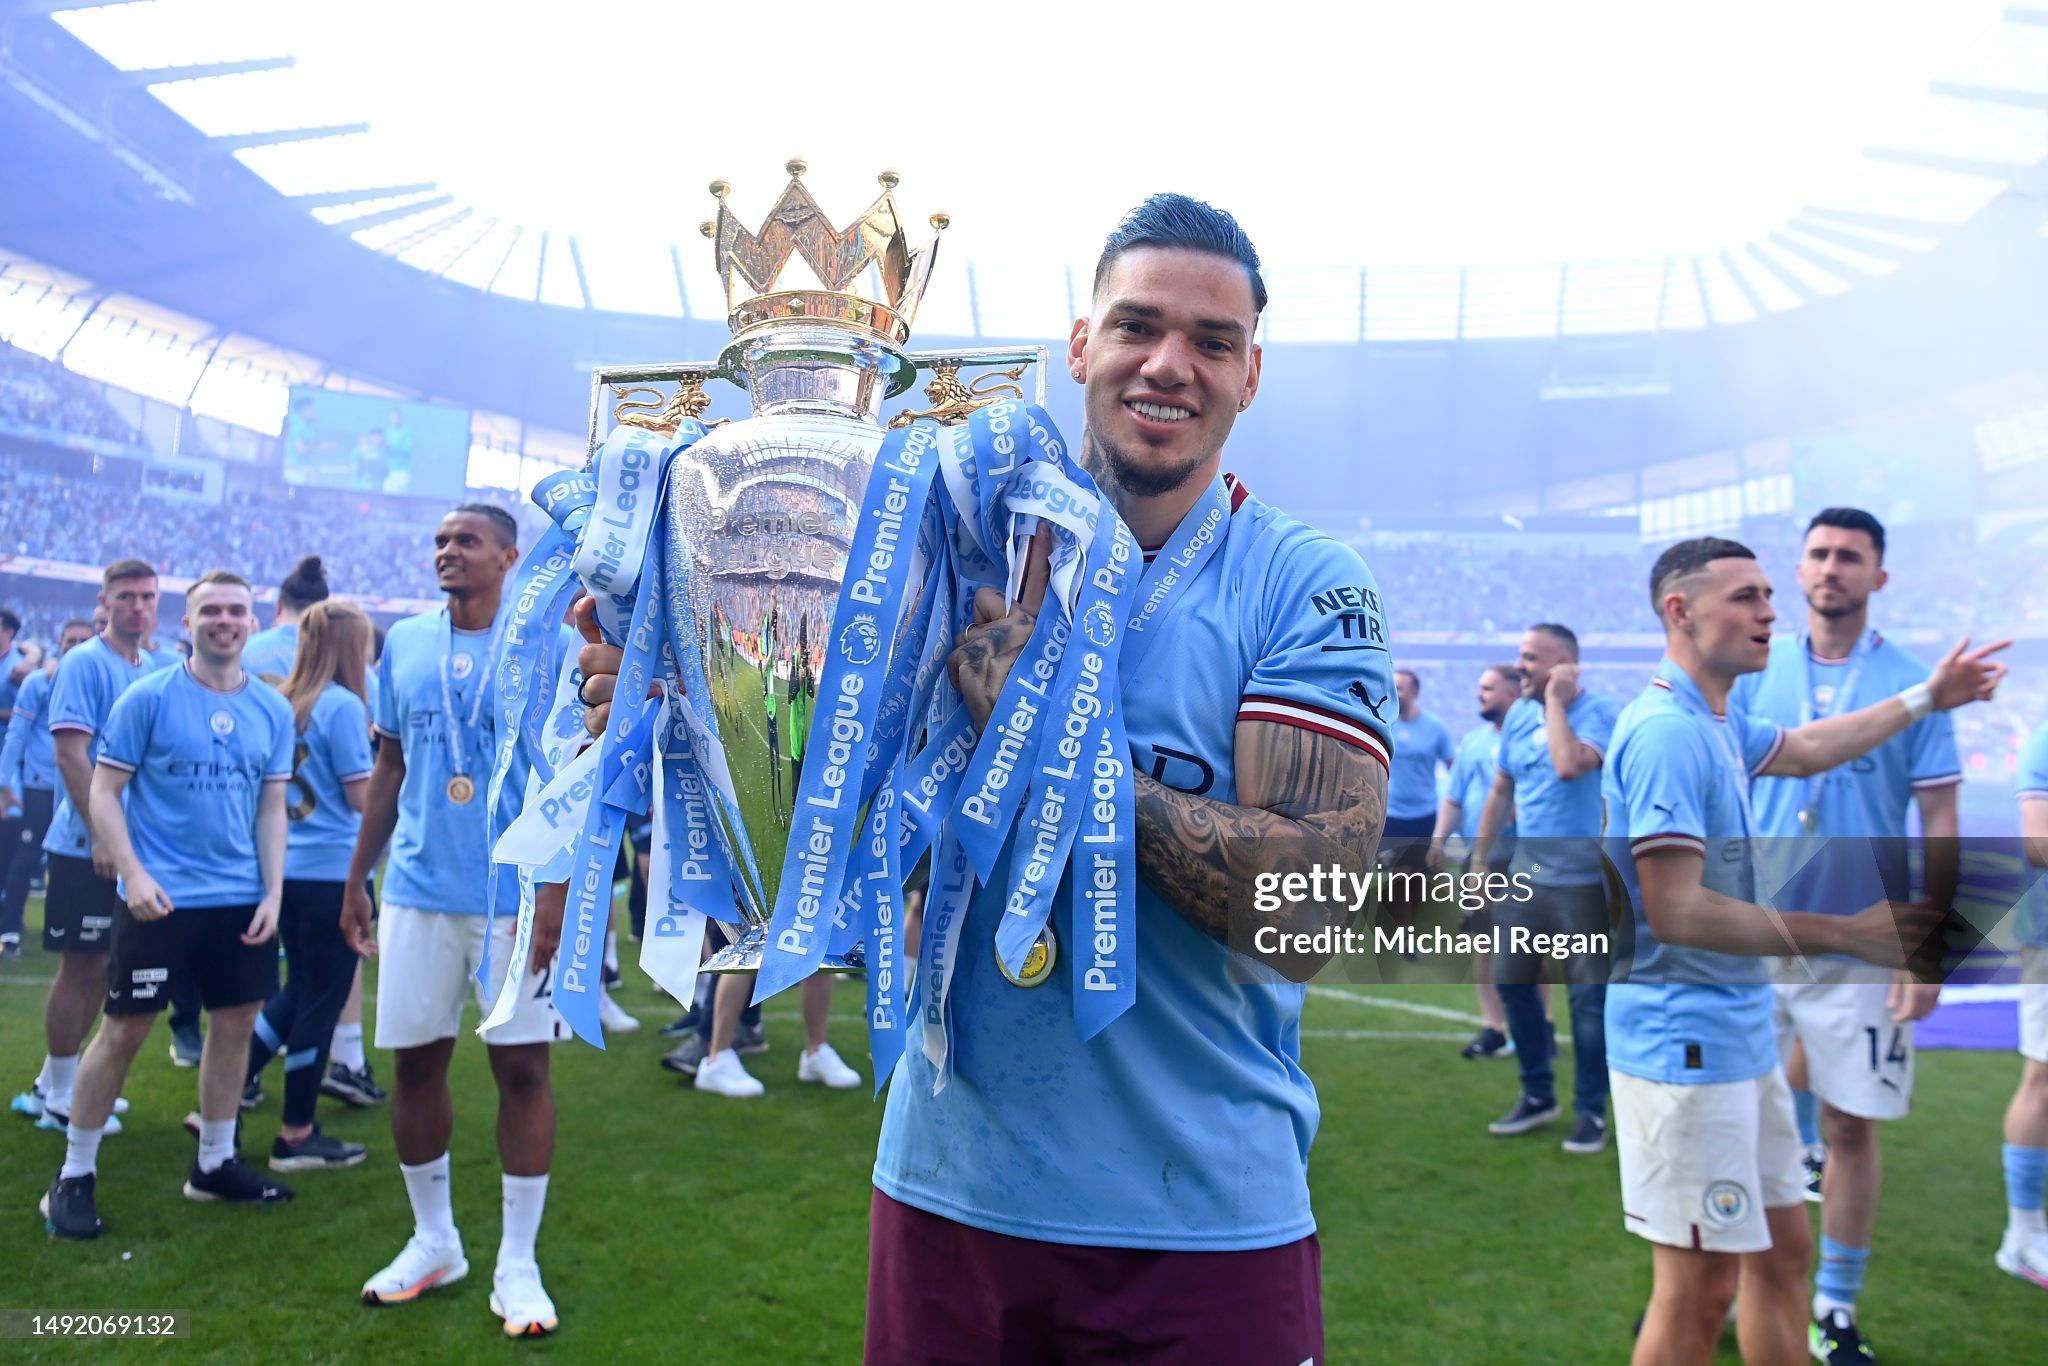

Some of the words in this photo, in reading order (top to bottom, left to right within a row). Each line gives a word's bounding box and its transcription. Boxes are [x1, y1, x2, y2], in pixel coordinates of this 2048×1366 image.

[506, 544, 575, 646] Premier
[851, 476, 911, 605] Premier
[1127, 566, 1181, 633] Premier
[1170, 507, 1223, 576] League
[805, 673, 865, 810] League
[960, 695, 1039, 826] Premier
[1007, 785, 1066, 918] Premier
[1042, 652, 1103, 781] League
[675, 768, 712, 881] Premier
[776, 817, 835, 956] Premier
[562, 854, 603, 994] Premier
[873, 889, 894, 1030] Premier
[926, 900, 957, 1026] Premier
[1084, 853, 1118, 992] Premier
[1863, 1025, 1908, 1073] 14
